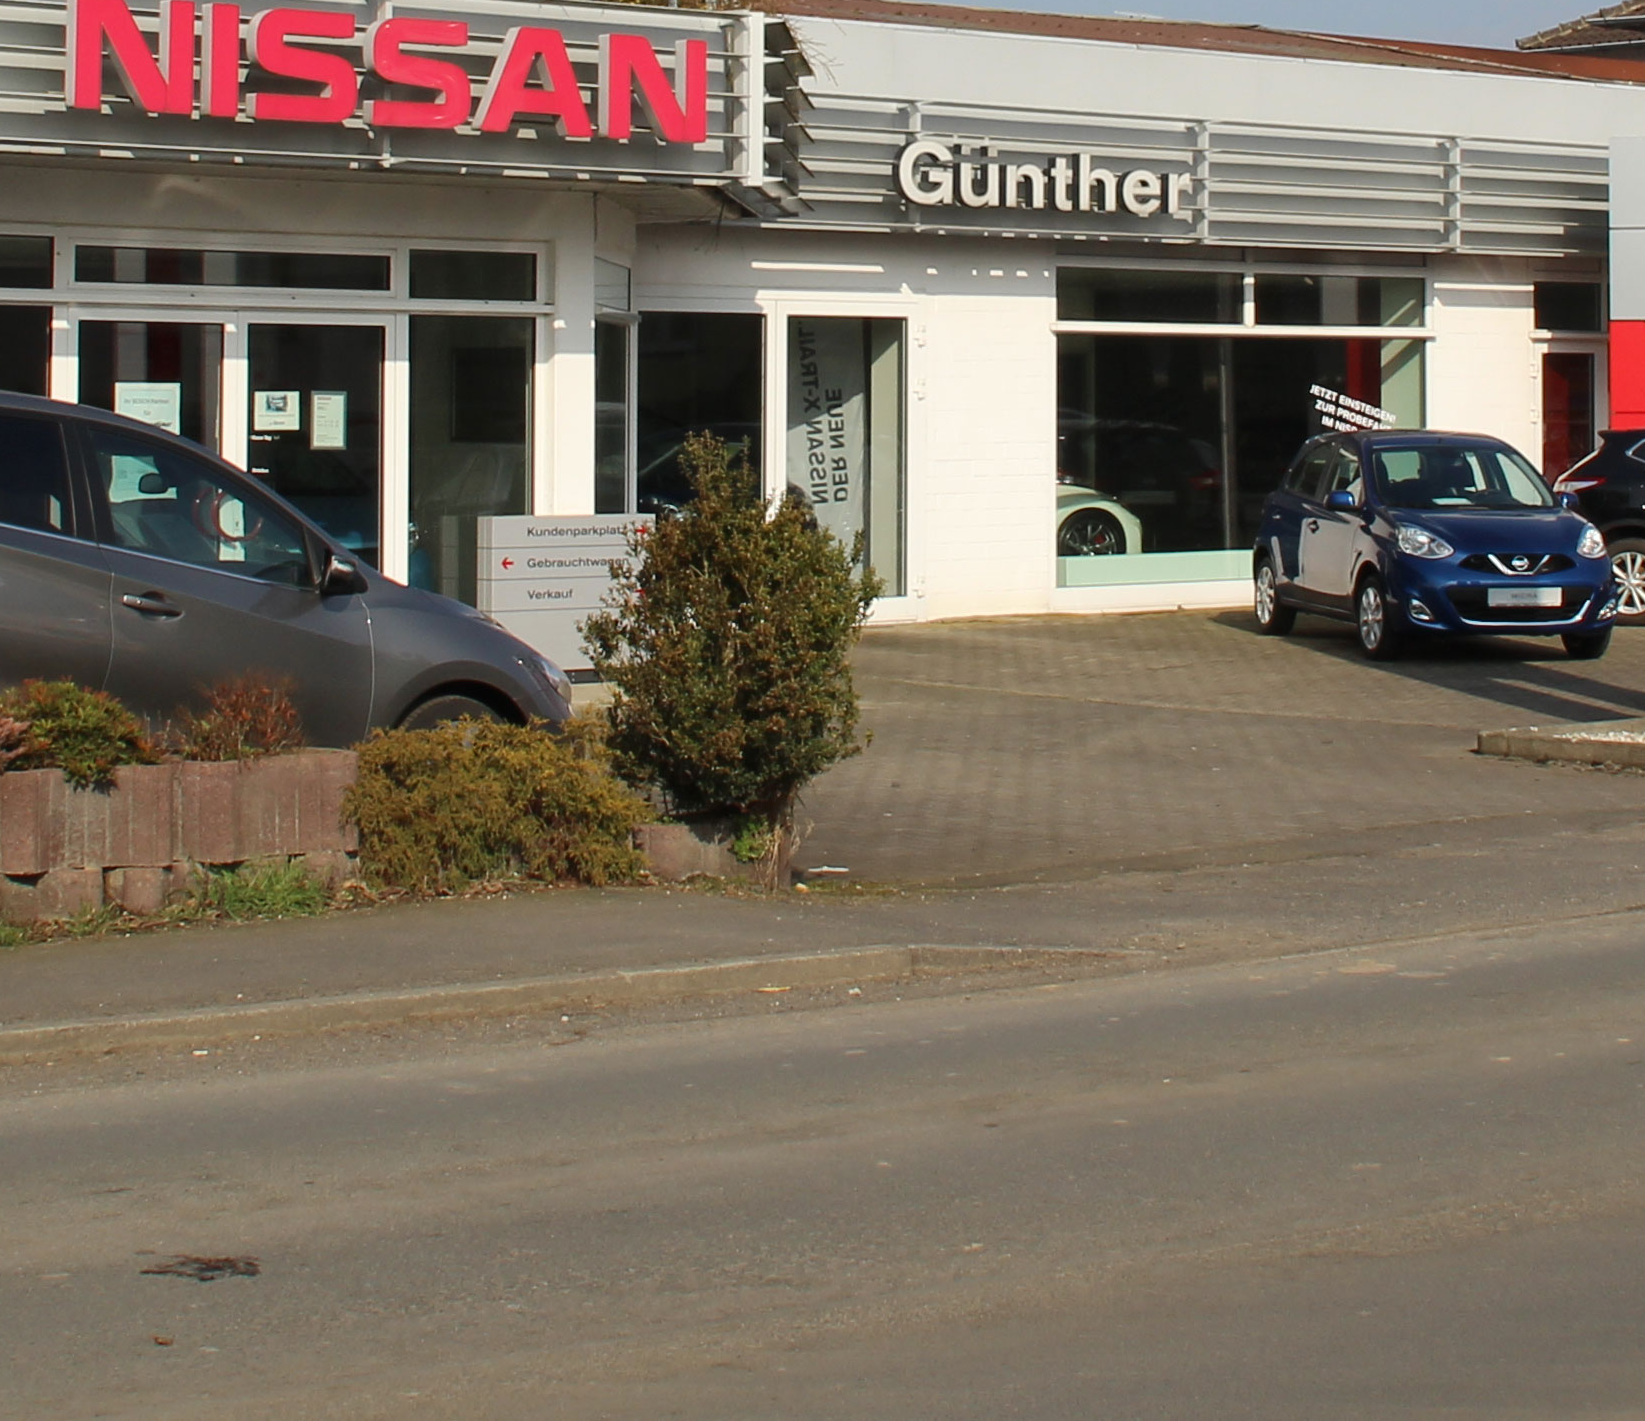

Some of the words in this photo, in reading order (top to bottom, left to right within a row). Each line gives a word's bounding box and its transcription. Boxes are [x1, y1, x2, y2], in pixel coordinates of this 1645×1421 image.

[895, 140, 1191, 217] Günther
[1309, 384, 1338, 402] JETZT
[1338, 394, 1397, 423] EINSTEIGEN!
[1314, 399, 1336, 415] ZUR
[1321, 415, 1334, 428] IM
[527, 589, 573, 600] Verkauf
